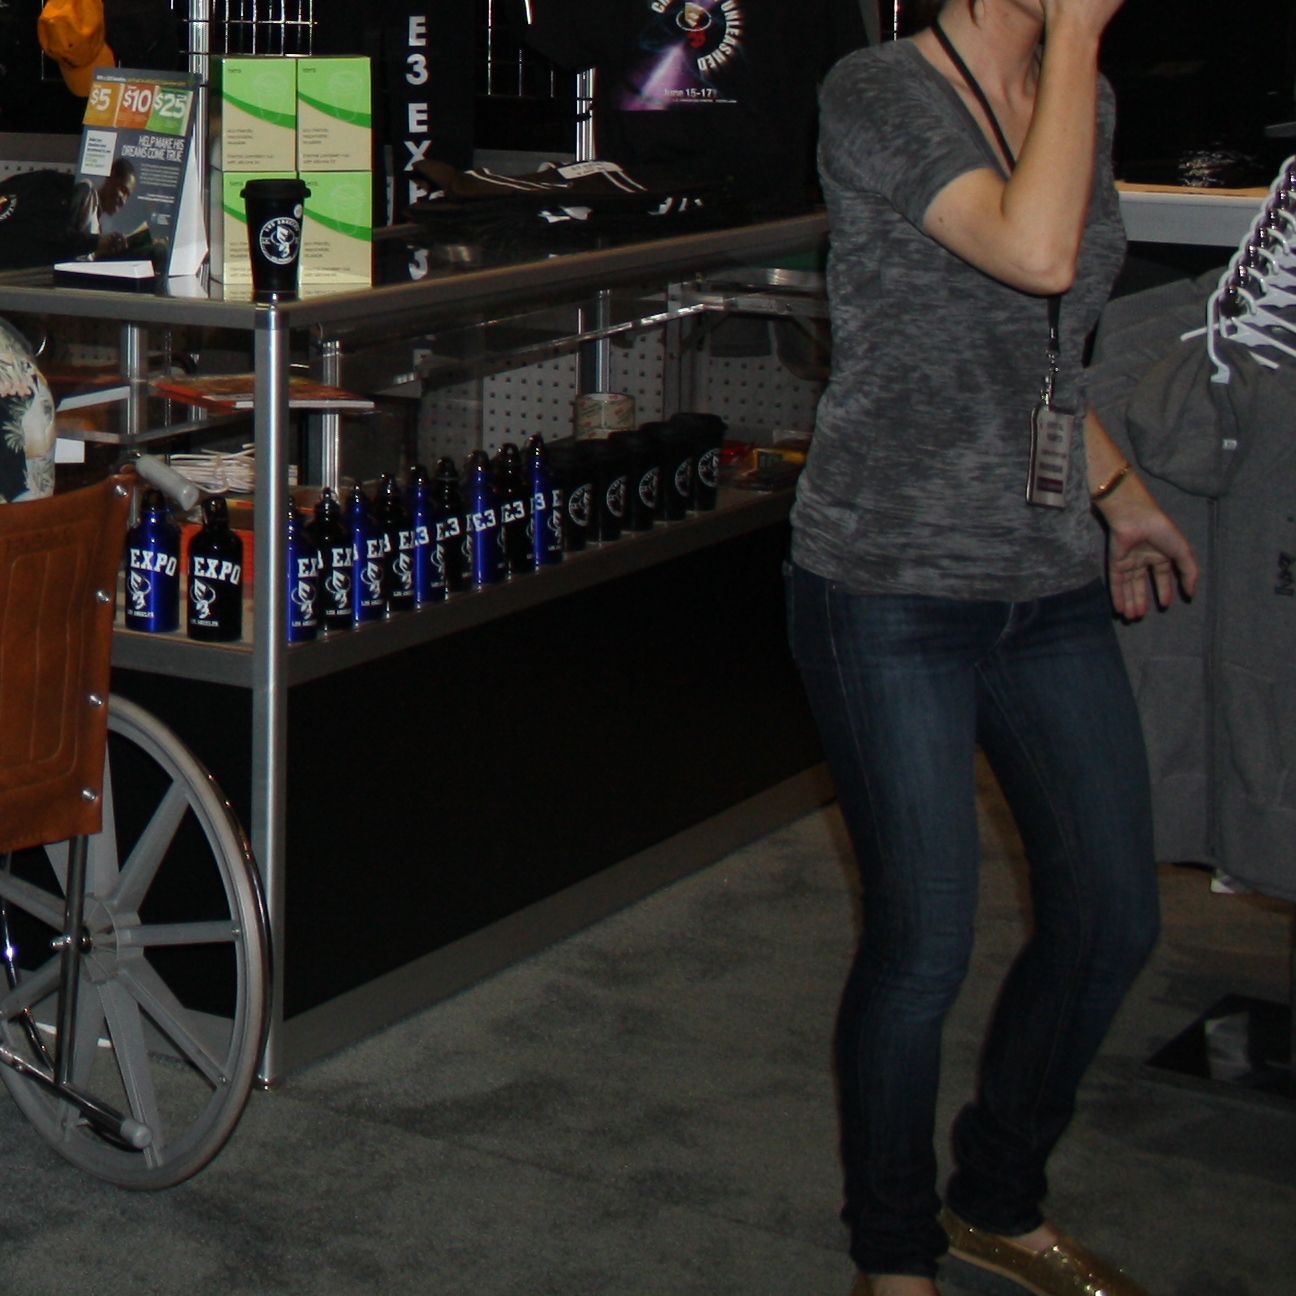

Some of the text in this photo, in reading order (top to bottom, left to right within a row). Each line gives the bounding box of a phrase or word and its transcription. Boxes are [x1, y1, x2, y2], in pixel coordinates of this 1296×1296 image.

[406, 15, 429, 85] E3
[696, 0, 745, 72] UNLEASHED
[90, 88, 188, 119] $5 $10 $25
[130, 548, 177, 576] EXPO
[193, 556, 241, 585] EXPO
